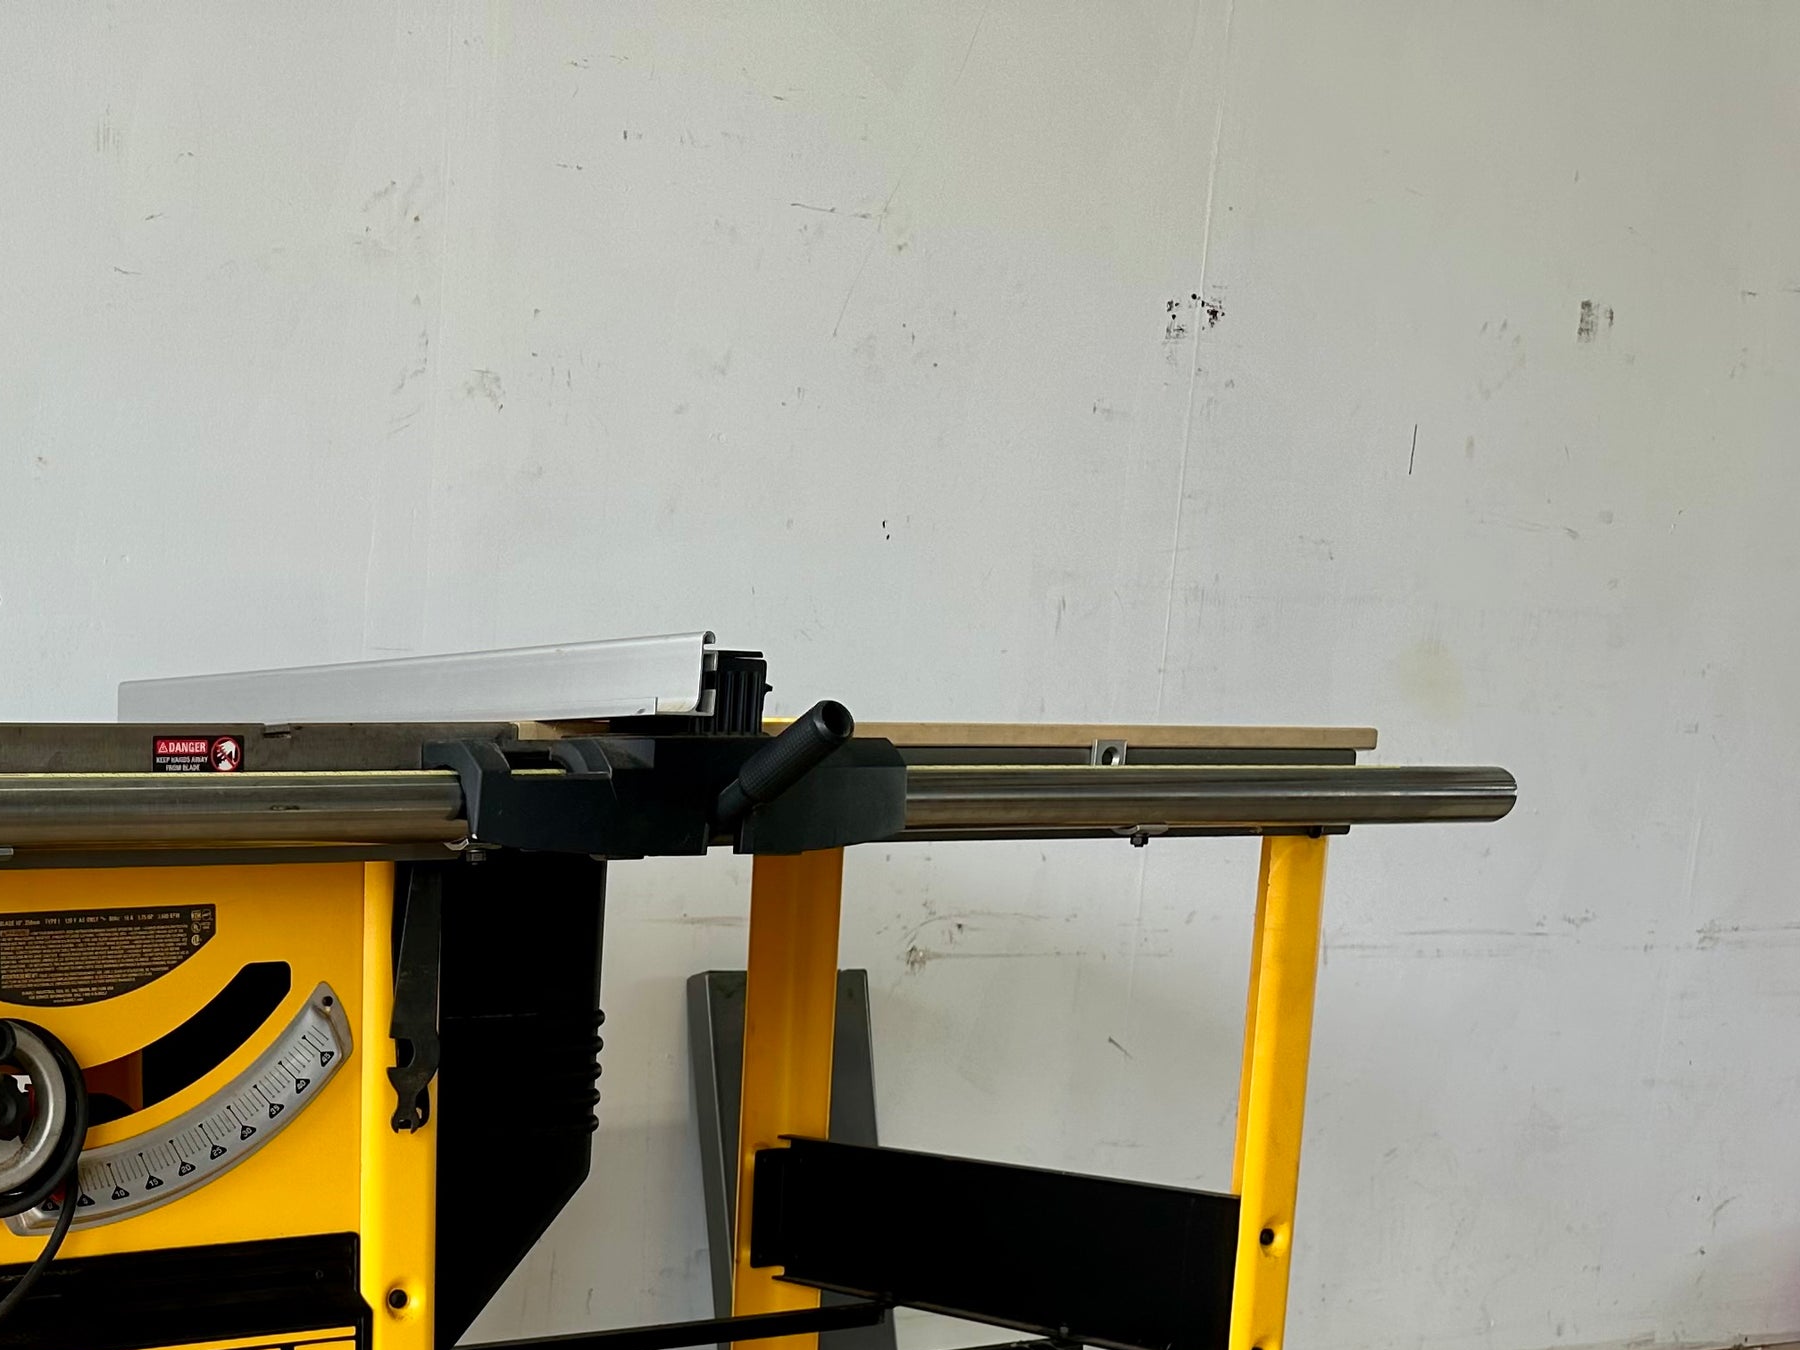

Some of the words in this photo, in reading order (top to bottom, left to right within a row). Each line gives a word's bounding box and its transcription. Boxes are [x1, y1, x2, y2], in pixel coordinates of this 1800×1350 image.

[169, 741, 206, 753] DANGER
[115, 1189, 126, 1197] 10
[148, 1178, 159, 1187] 15
[181, 1163, 192, 1174] 20
[212, 1146, 223, 1157] 25
[242, 1127, 252, 1138] 30
[270, 1104, 280, 1115] 35
[297, 1080, 306, 1090] 40
[321, 1053, 332, 1063] 45
